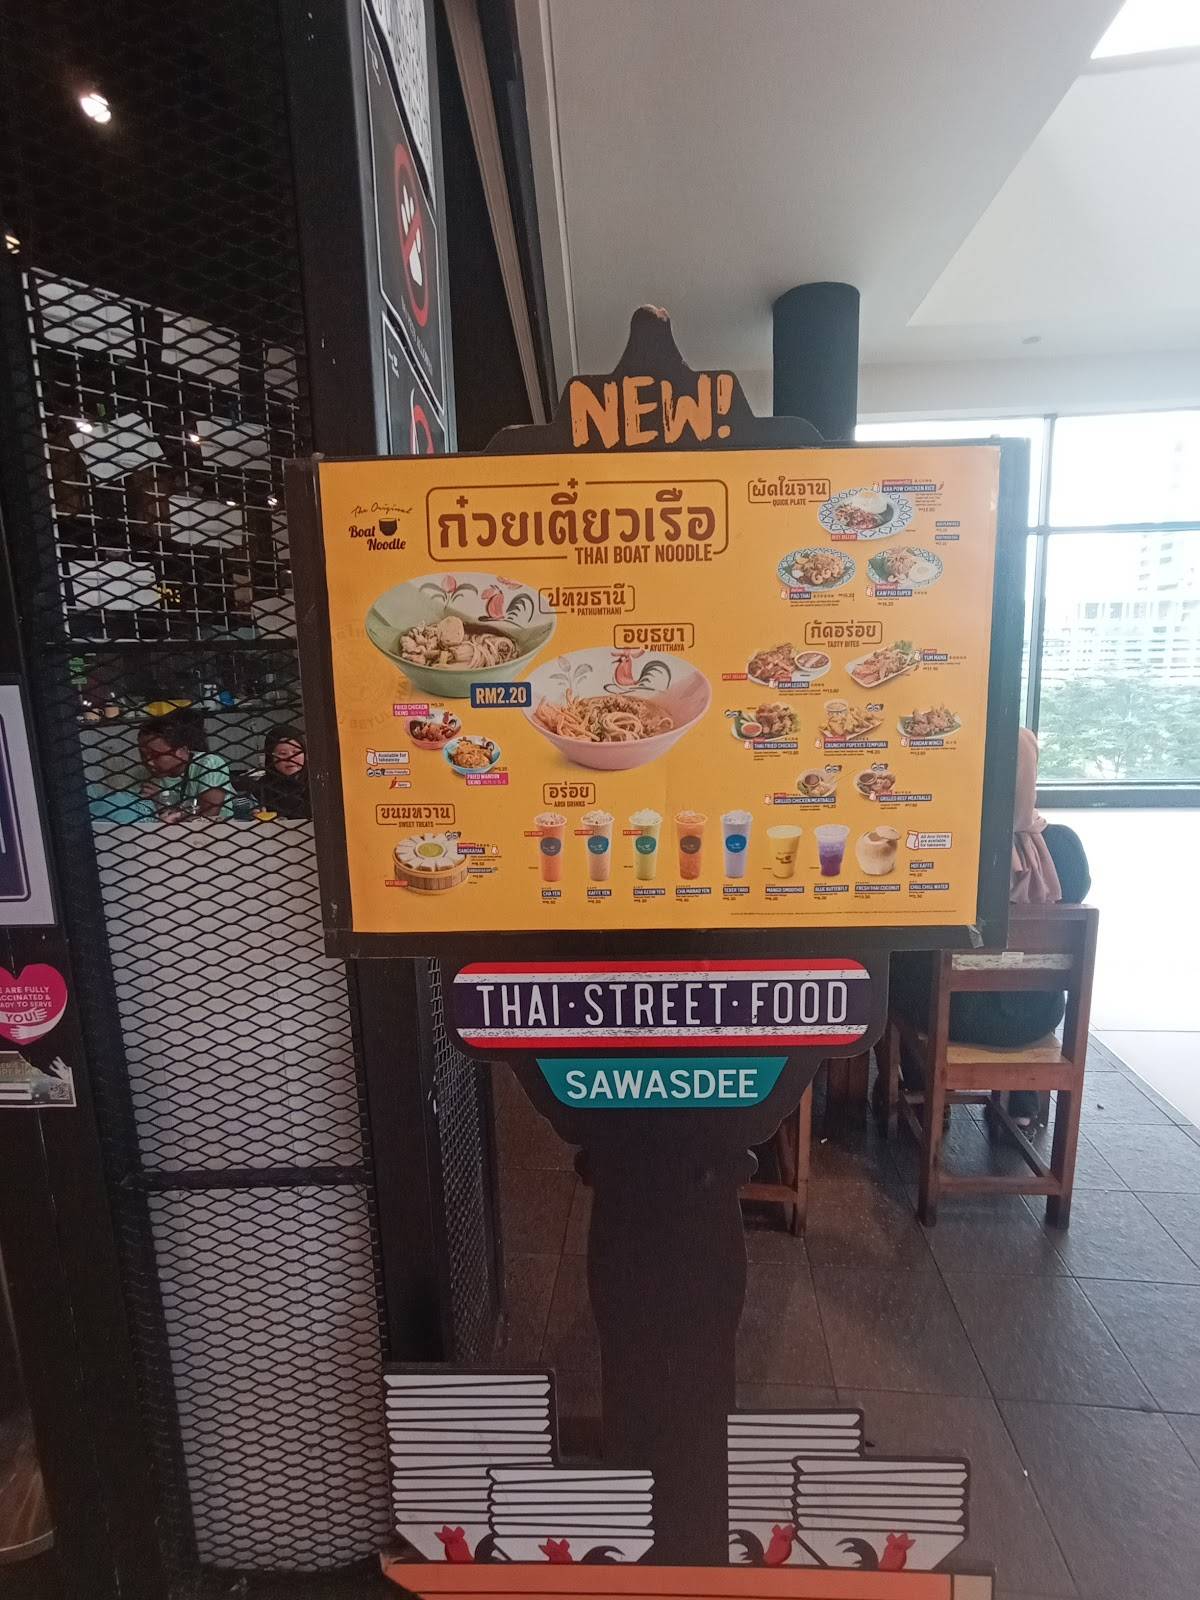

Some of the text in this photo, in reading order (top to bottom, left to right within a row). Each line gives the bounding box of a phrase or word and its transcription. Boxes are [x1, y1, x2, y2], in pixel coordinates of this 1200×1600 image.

[569, 374, 734, 449] NEW!
[371, 502, 413, 514] Original
[348, 525, 375, 538] Boat
[367, 538, 406, 551] Noodle
[575, 544, 712, 565] THAI BOAT NOODLE
[827, 640, 860, 648] TASTY BITES
[475, 687, 527, 704] RM2.20
[476, 981, 848, 1026] THAI STREET FOOD
[5, 1012, 39, 1024] YOU!
[566, 1069, 758, 1101] SAWASDEE
